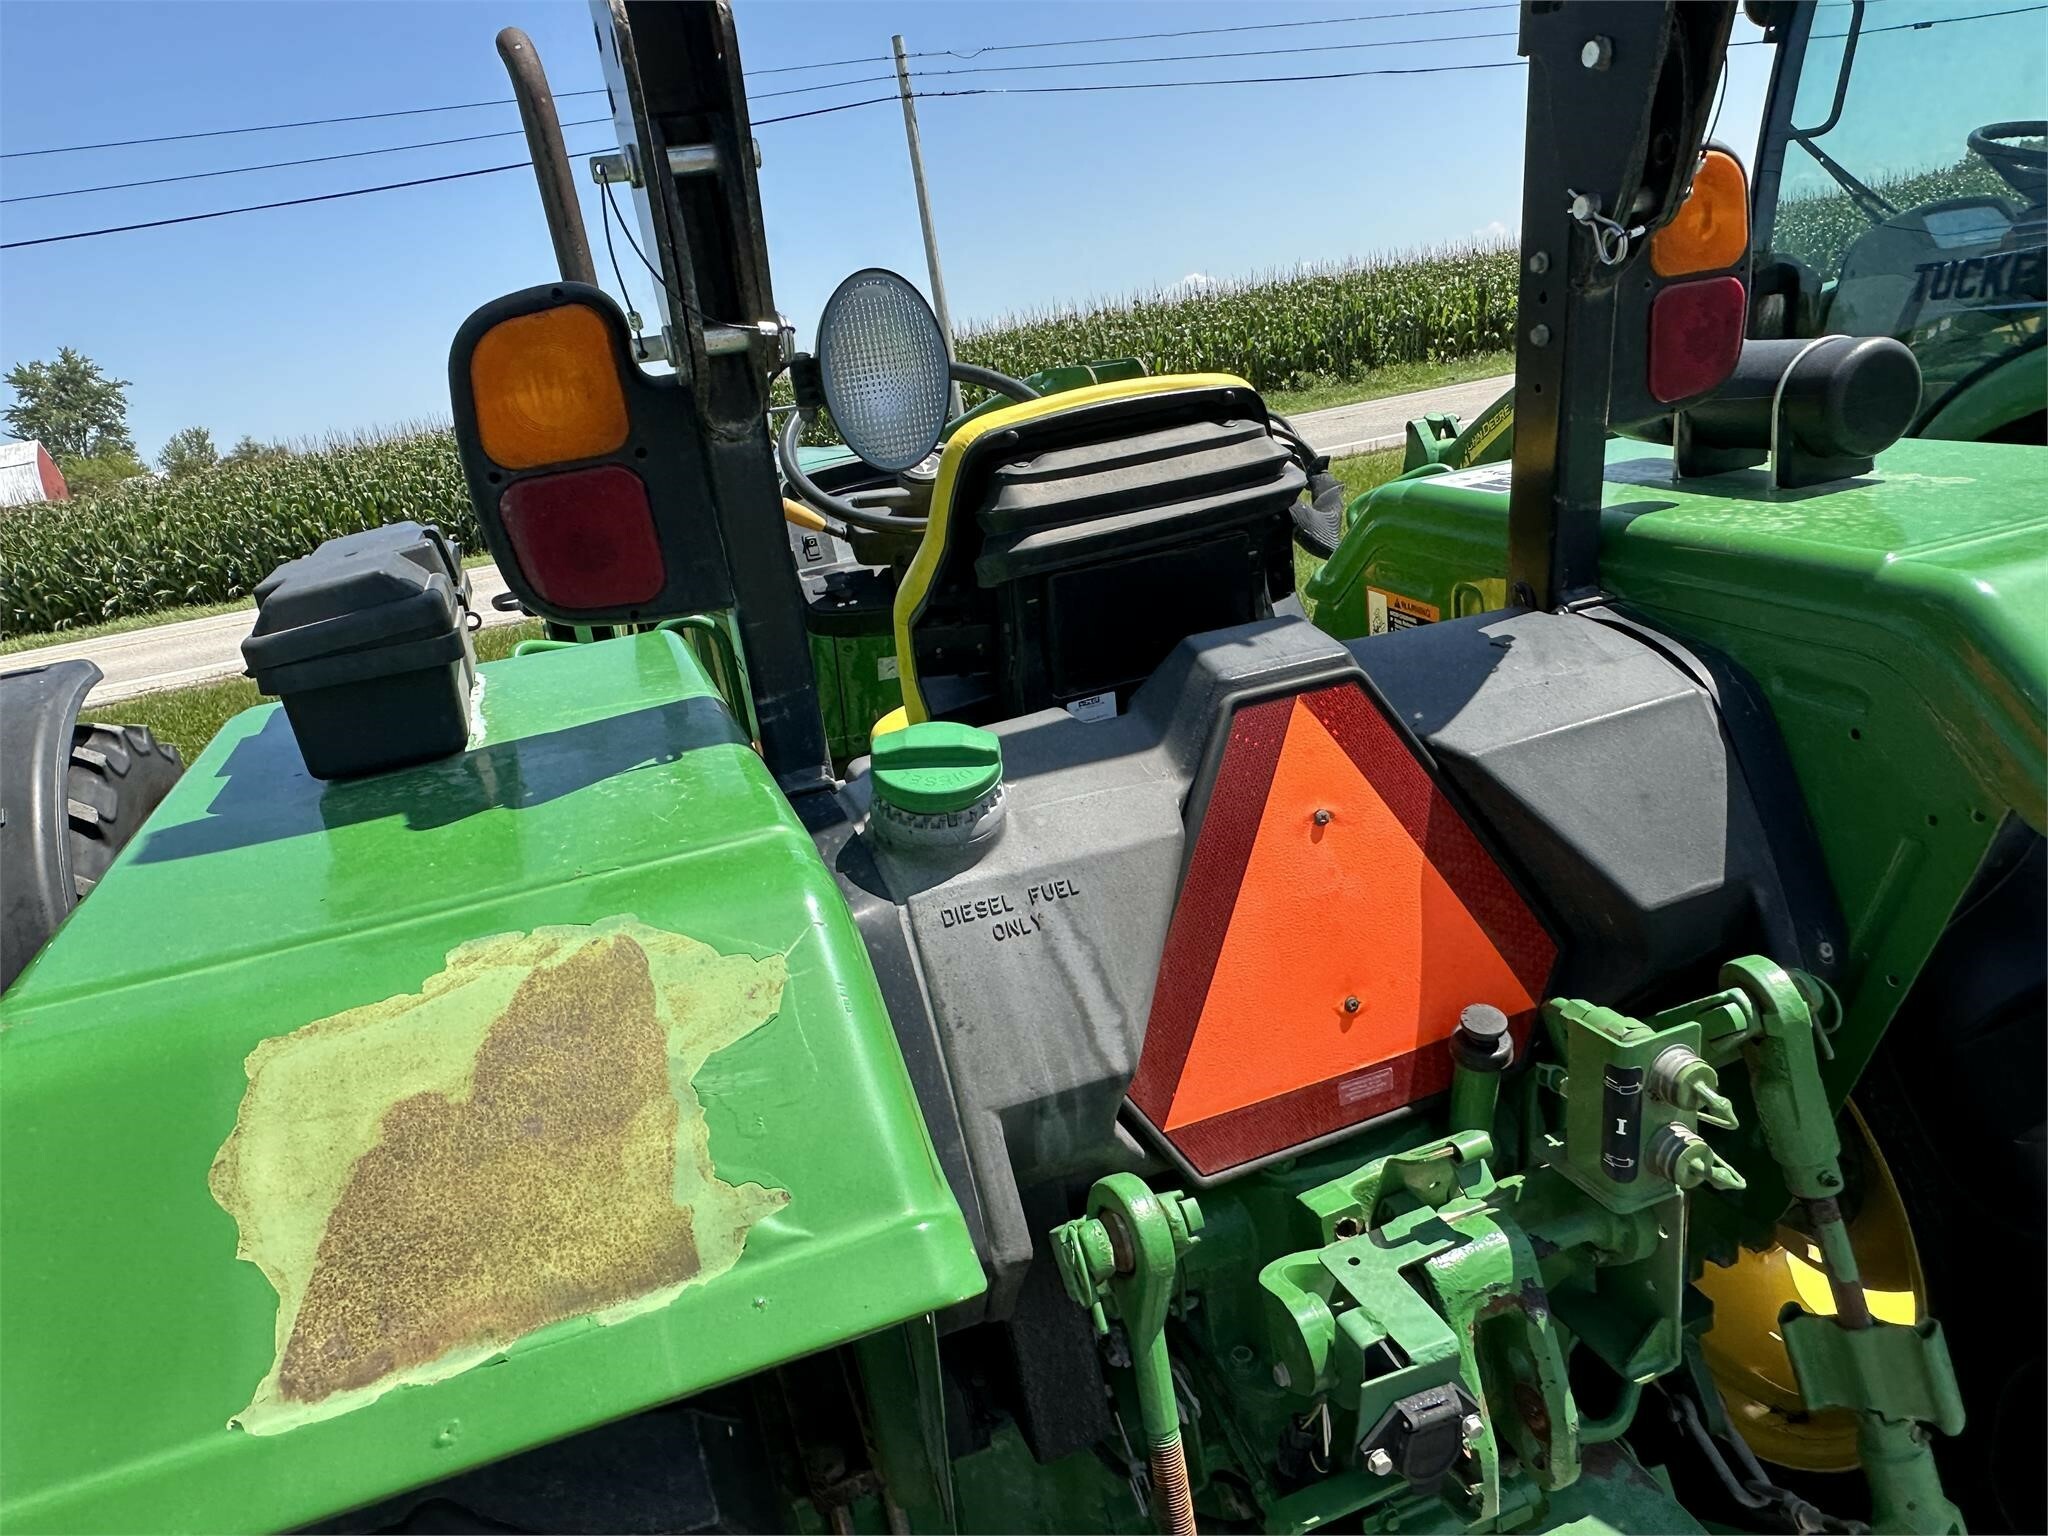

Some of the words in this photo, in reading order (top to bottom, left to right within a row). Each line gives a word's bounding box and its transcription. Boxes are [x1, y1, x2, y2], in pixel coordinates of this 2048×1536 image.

[1482, 404, 1512, 436] DEERE
[940, 895, 1014, 929] DIESEL
[1027, 879, 1080, 906] FUEL
[992, 913, 1044, 942] ONLY
